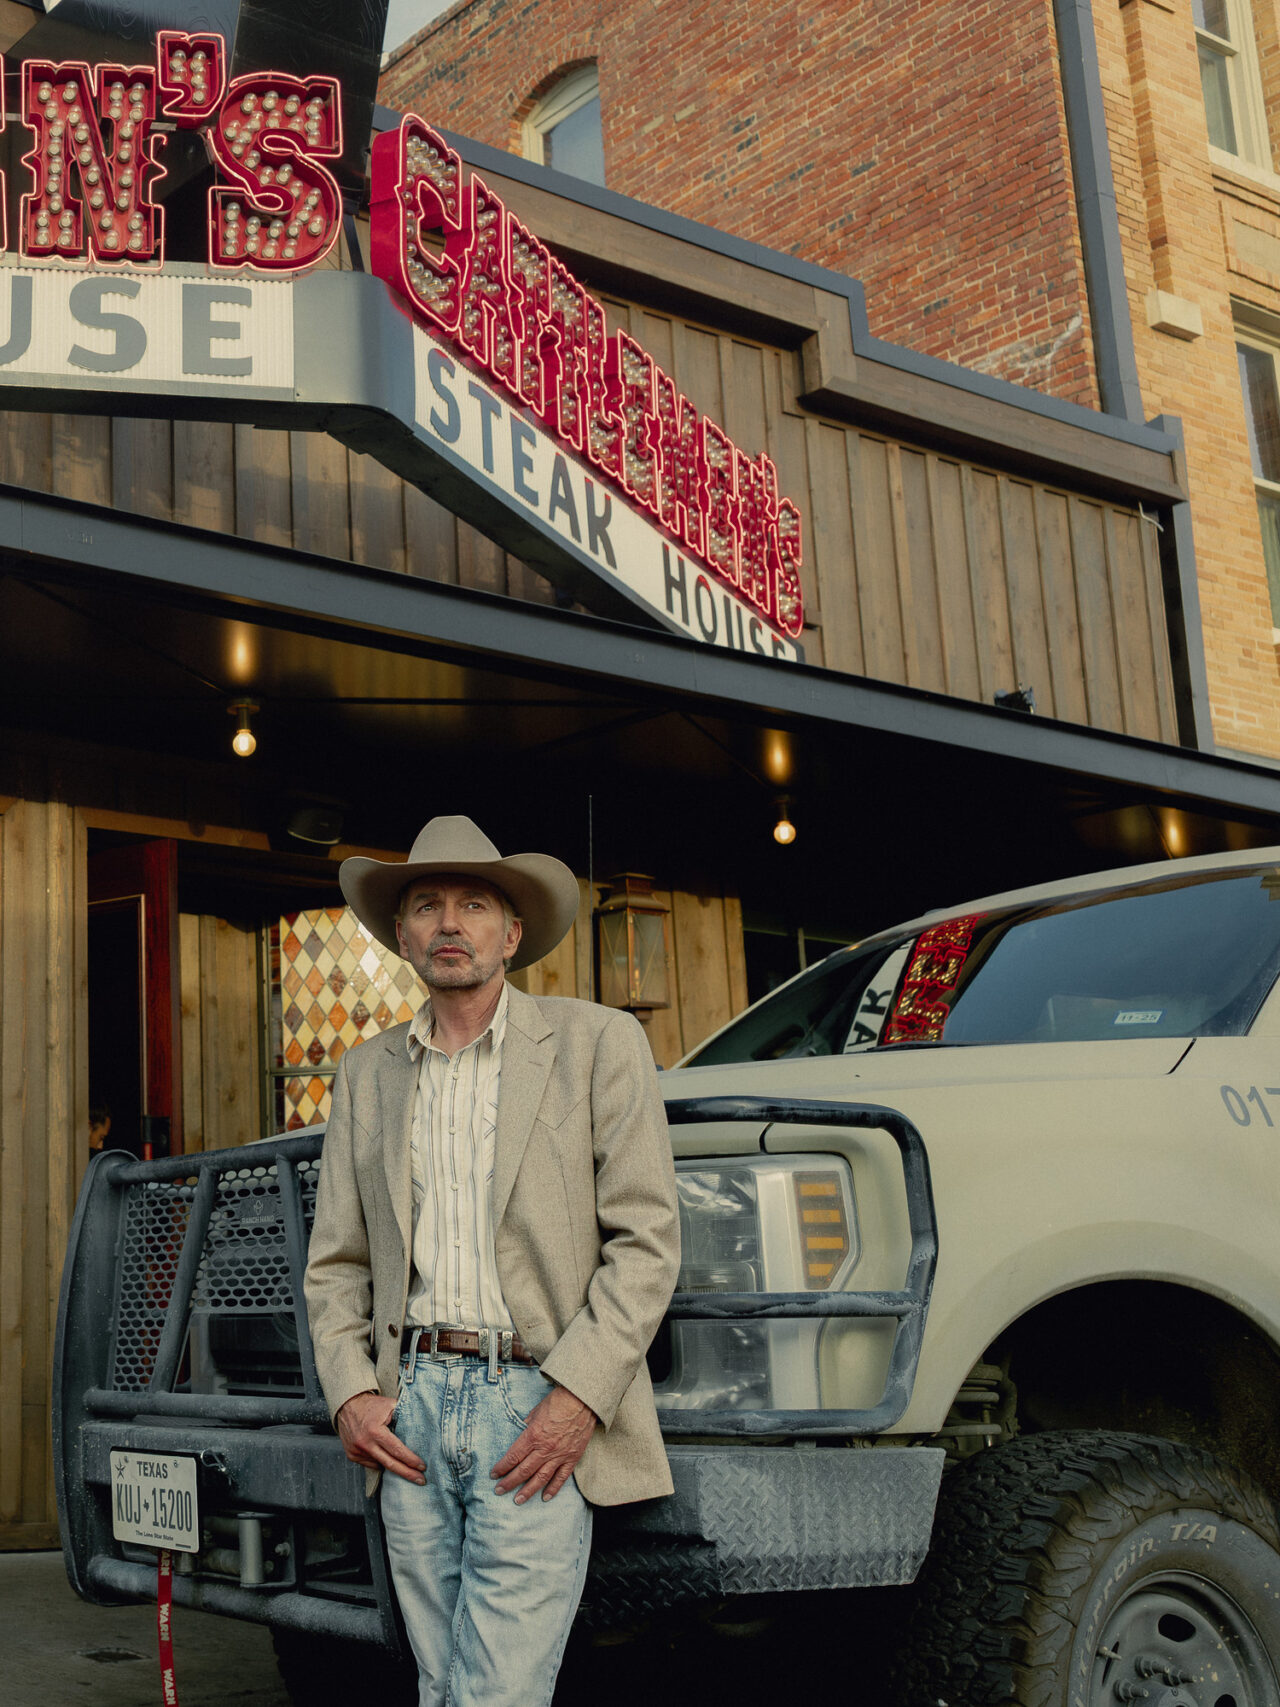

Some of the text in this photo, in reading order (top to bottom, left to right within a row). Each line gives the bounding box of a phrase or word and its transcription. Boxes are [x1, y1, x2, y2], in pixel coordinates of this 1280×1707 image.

[372, 113, 804, 638] CATTLEMEN'S
[426, 348, 617, 570] STEAK
[136, 1460, 169, 1479] TEXAS
[135, 1529, 143, 1537] The
[1169, 1523, 1217, 1543] T/A
[160, 1550, 170, 1576] ARN
[159, 1602, 170, 1641] WARN
[162, 1667, 177, 1706] WARN
